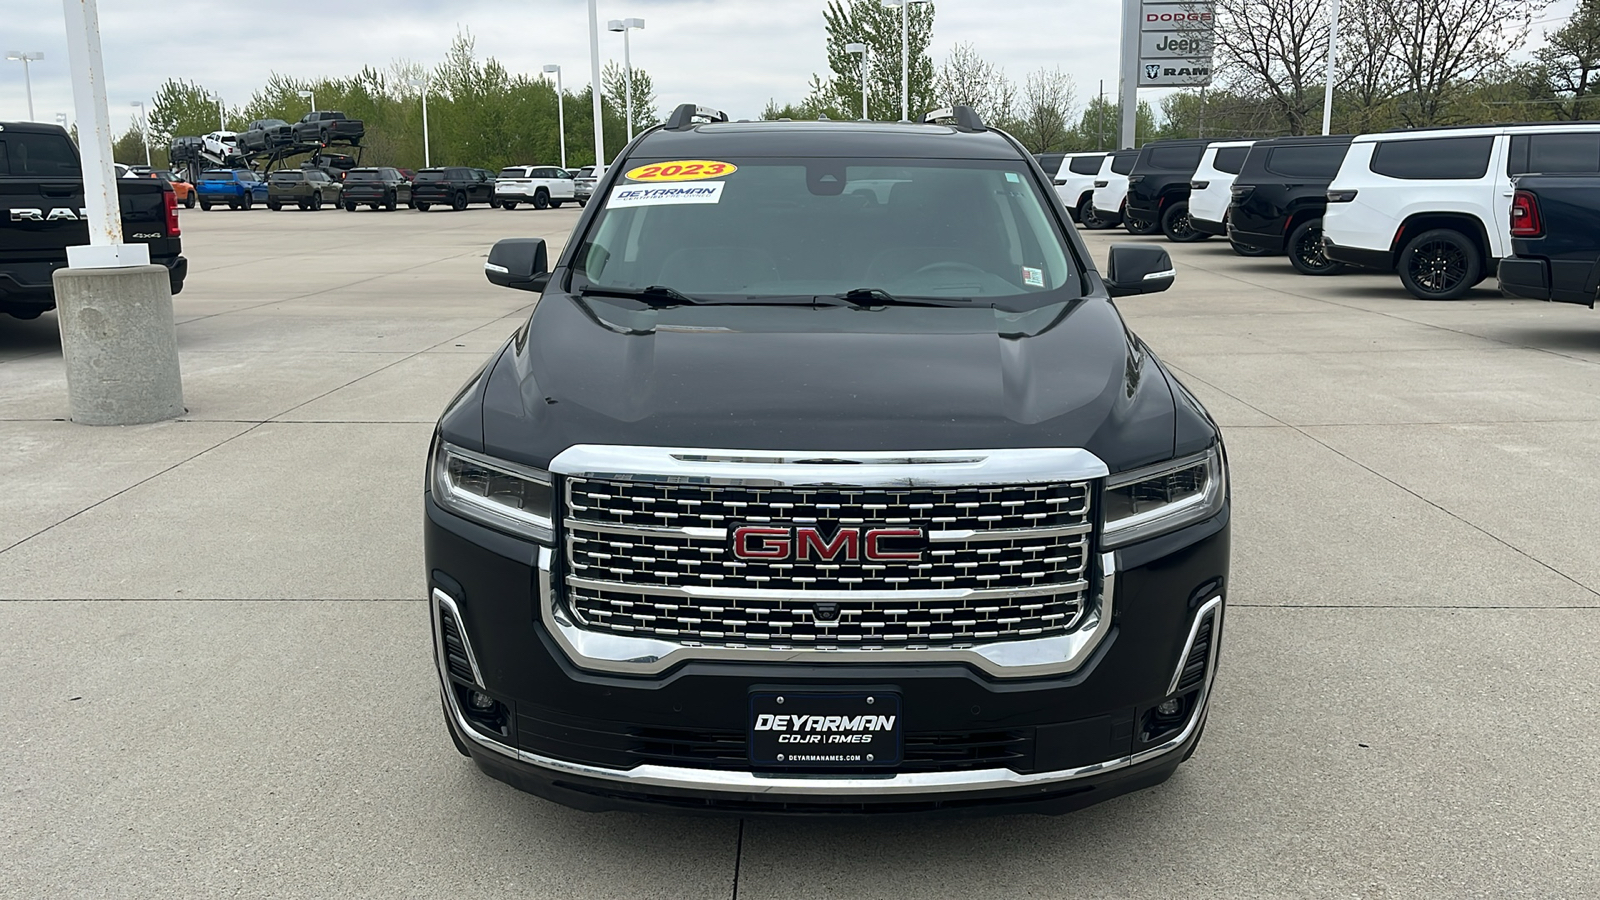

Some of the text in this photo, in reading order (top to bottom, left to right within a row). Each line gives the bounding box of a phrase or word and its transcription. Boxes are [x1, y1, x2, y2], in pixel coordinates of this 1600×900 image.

[1146, 12, 1212, 22] DODGE
[1156, 35, 1200, 54] Jeep
[1163, 67, 1209, 76] RAM
[637, 163, 726, 179] 2023
[617, 187, 716, 199] DEYARMAN
[732, 526, 924, 562] GMC
[754, 714, 896, 732] DEYARMAN
[828, 734, 873, 743] AMES
